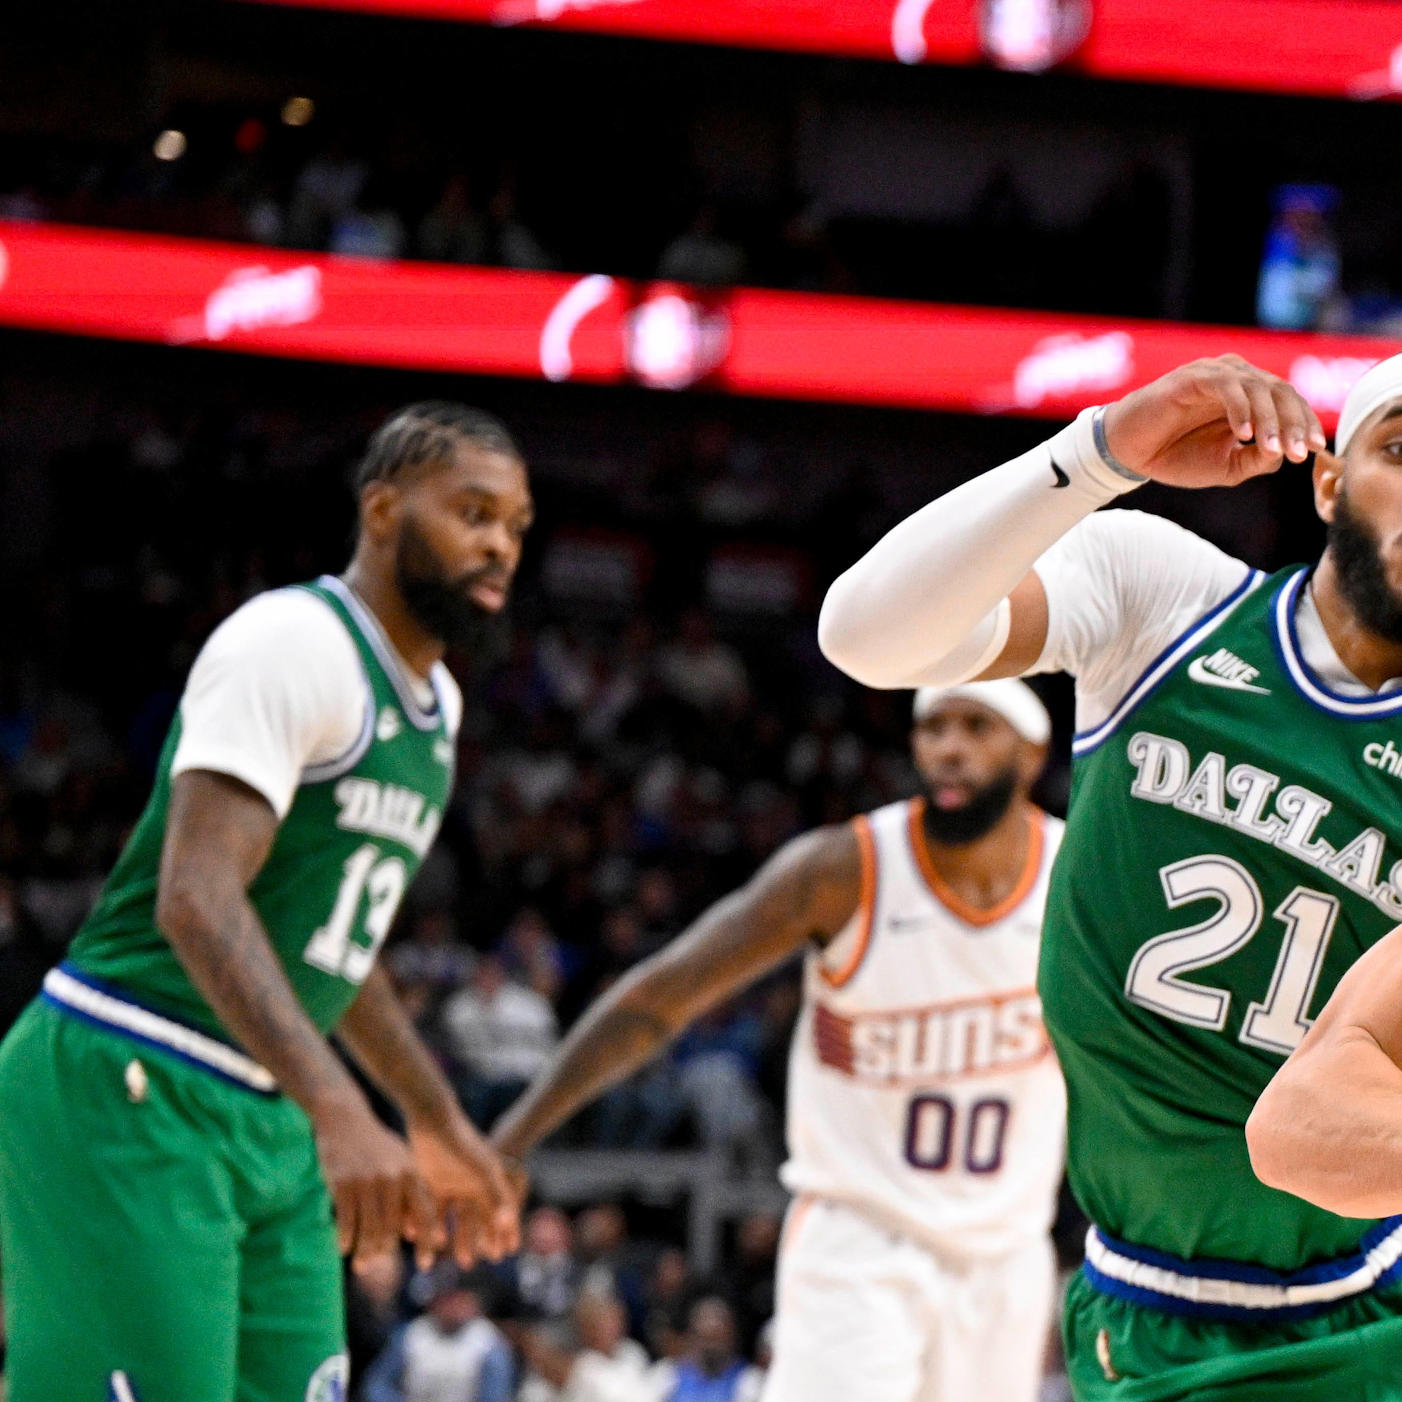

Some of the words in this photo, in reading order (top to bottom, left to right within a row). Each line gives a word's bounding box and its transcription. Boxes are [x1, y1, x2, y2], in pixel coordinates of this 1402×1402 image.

[1203, 647, 1261, 684] NIKE
[303, 842, 406, 985] 13
[1125, 854, 1339, 1055] 21
[904, 1091, 1011, 1176] 00
